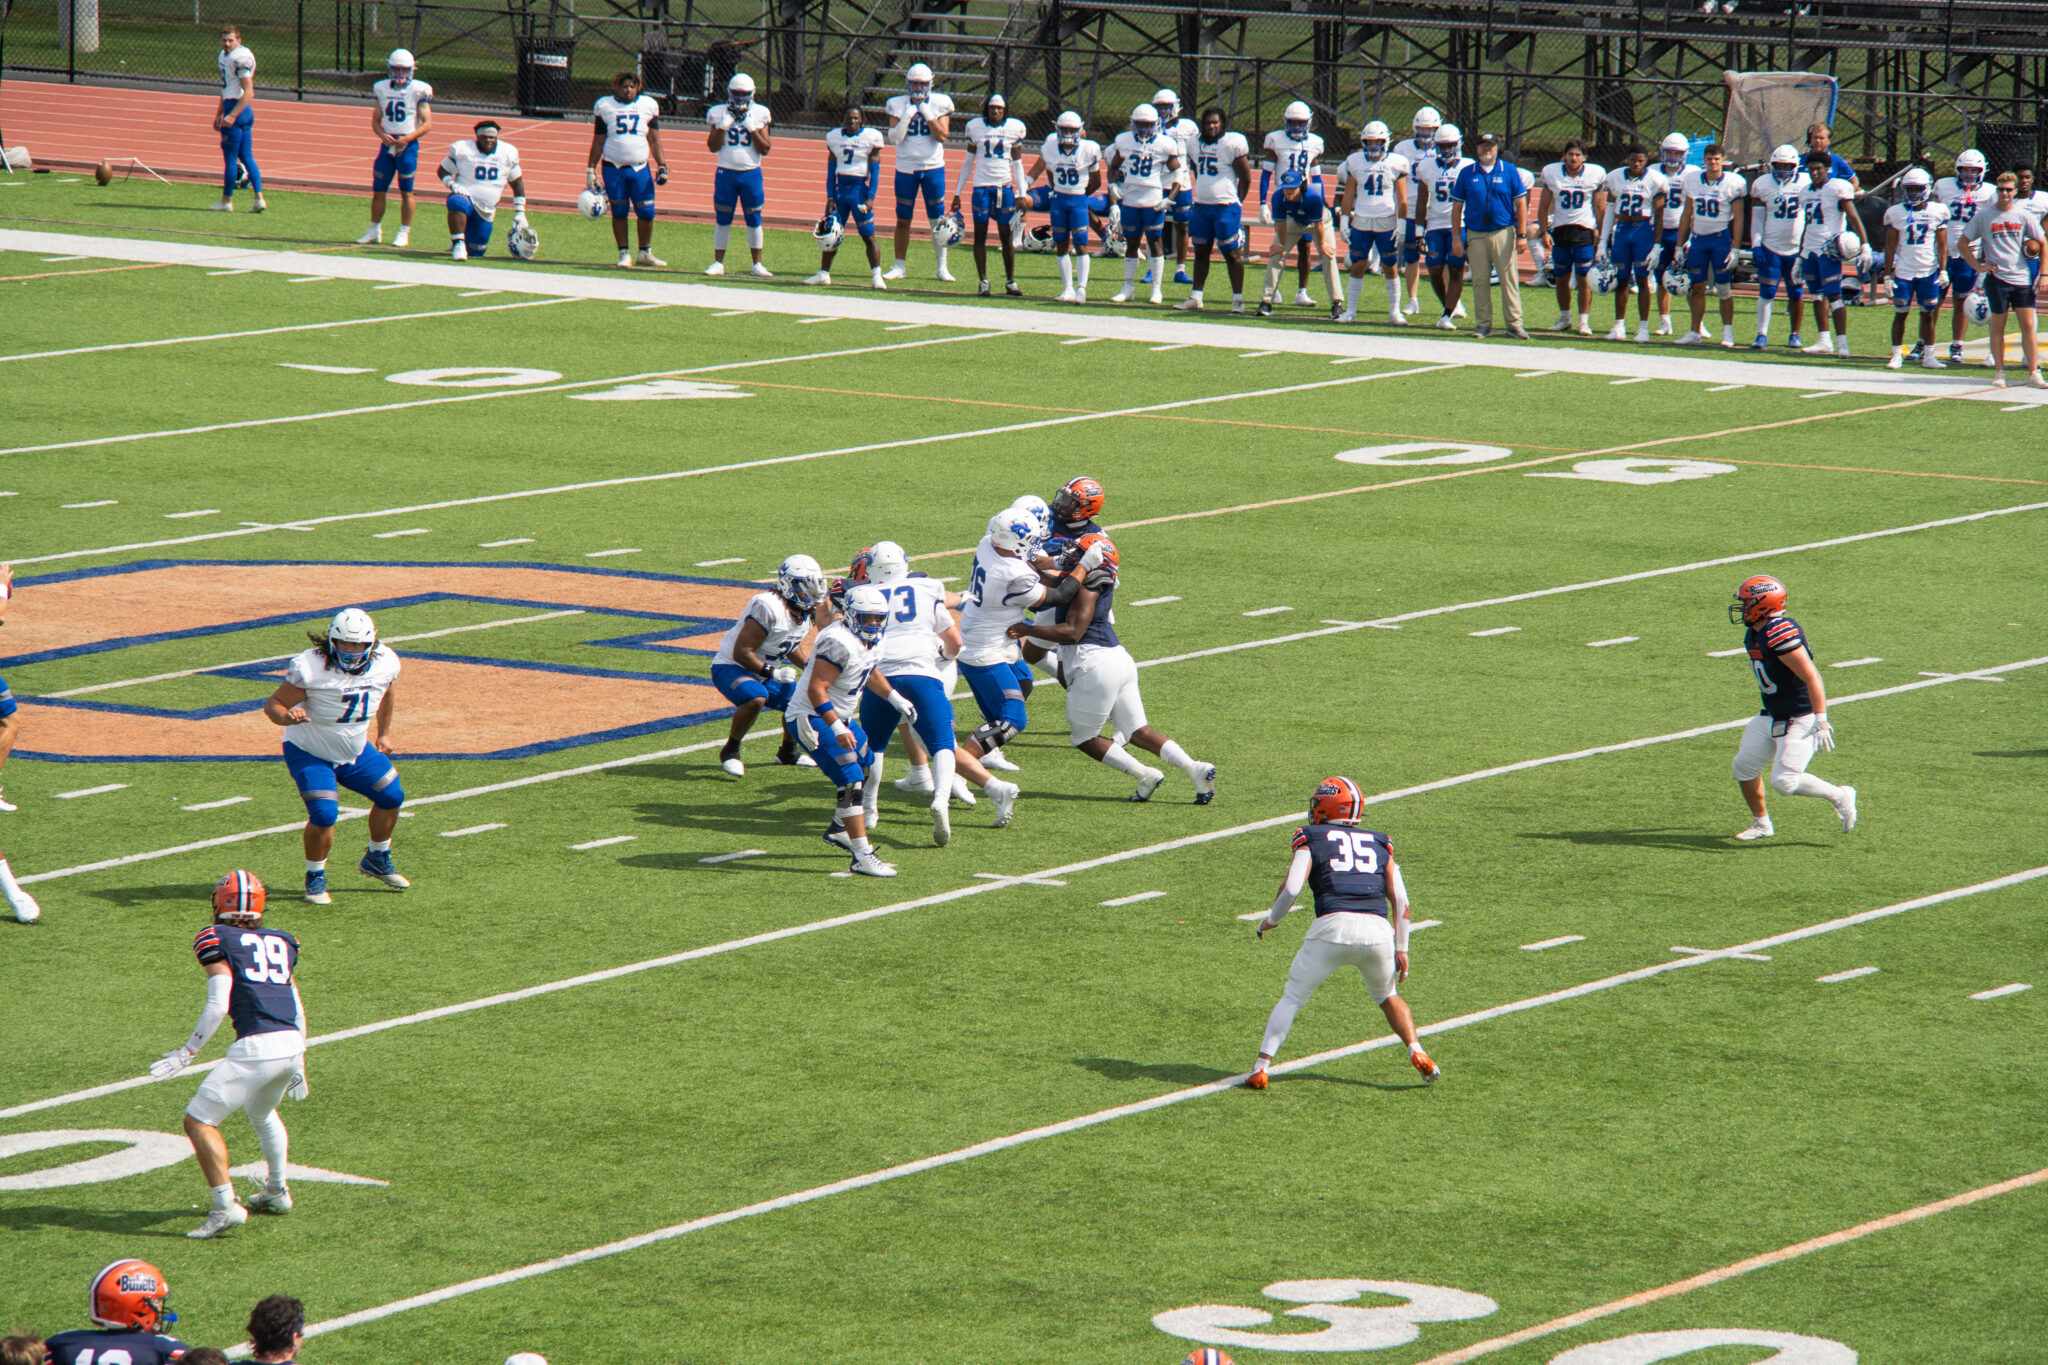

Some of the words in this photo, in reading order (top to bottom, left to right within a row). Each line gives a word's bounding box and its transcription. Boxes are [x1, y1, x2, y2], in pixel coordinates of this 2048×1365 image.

[386, 101, 406, 122] 46
[616, 115, 640, 135] 57
[728, 127, 751, 146] 93
[843, 148, 854, 164] 7
[984, 139, 1005, 158] 14
[1129, 154, 1153, 177] 38
[1197, 157, 1218, 176] 75
[1056, 167, 1079, 186] 38
[1364, 173, 1384, 196] 41
[1559, 190, 1584, 209] 30
[1620, 193, 1644, 216] 22
[1774, 196, 1800, 219] 32
[1949, 201, 1978, 223] 33
[1907, 223, 1929, 245] 17
[336, 691, 370, 724] 71
[1326, 830, 1378, 874] 35
[240, 933, 290, 984] 39
[120, 1274, 157, 1292] Bullets
